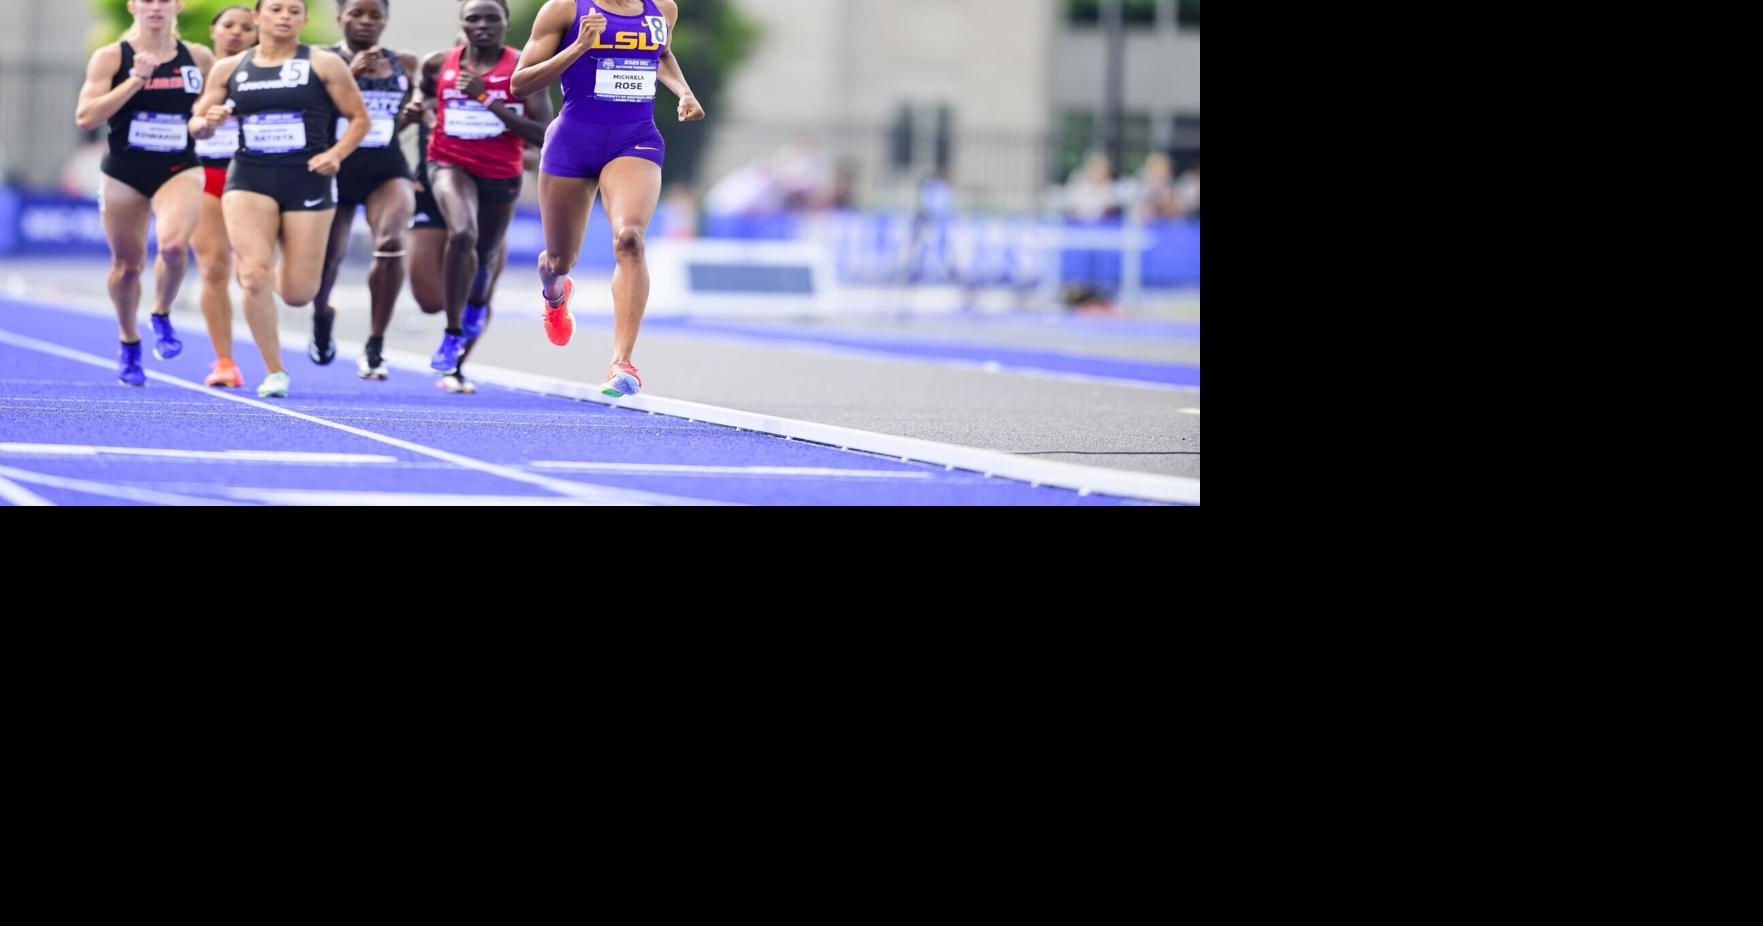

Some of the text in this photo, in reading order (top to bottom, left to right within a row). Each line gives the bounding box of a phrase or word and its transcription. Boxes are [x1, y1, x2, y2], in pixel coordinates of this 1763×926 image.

[651, 17, 665, 43] 8
[187, 69, 202, 90] 6
[287, 62, 302, 81] 5
[614, 82, 643, 90] ROSE
